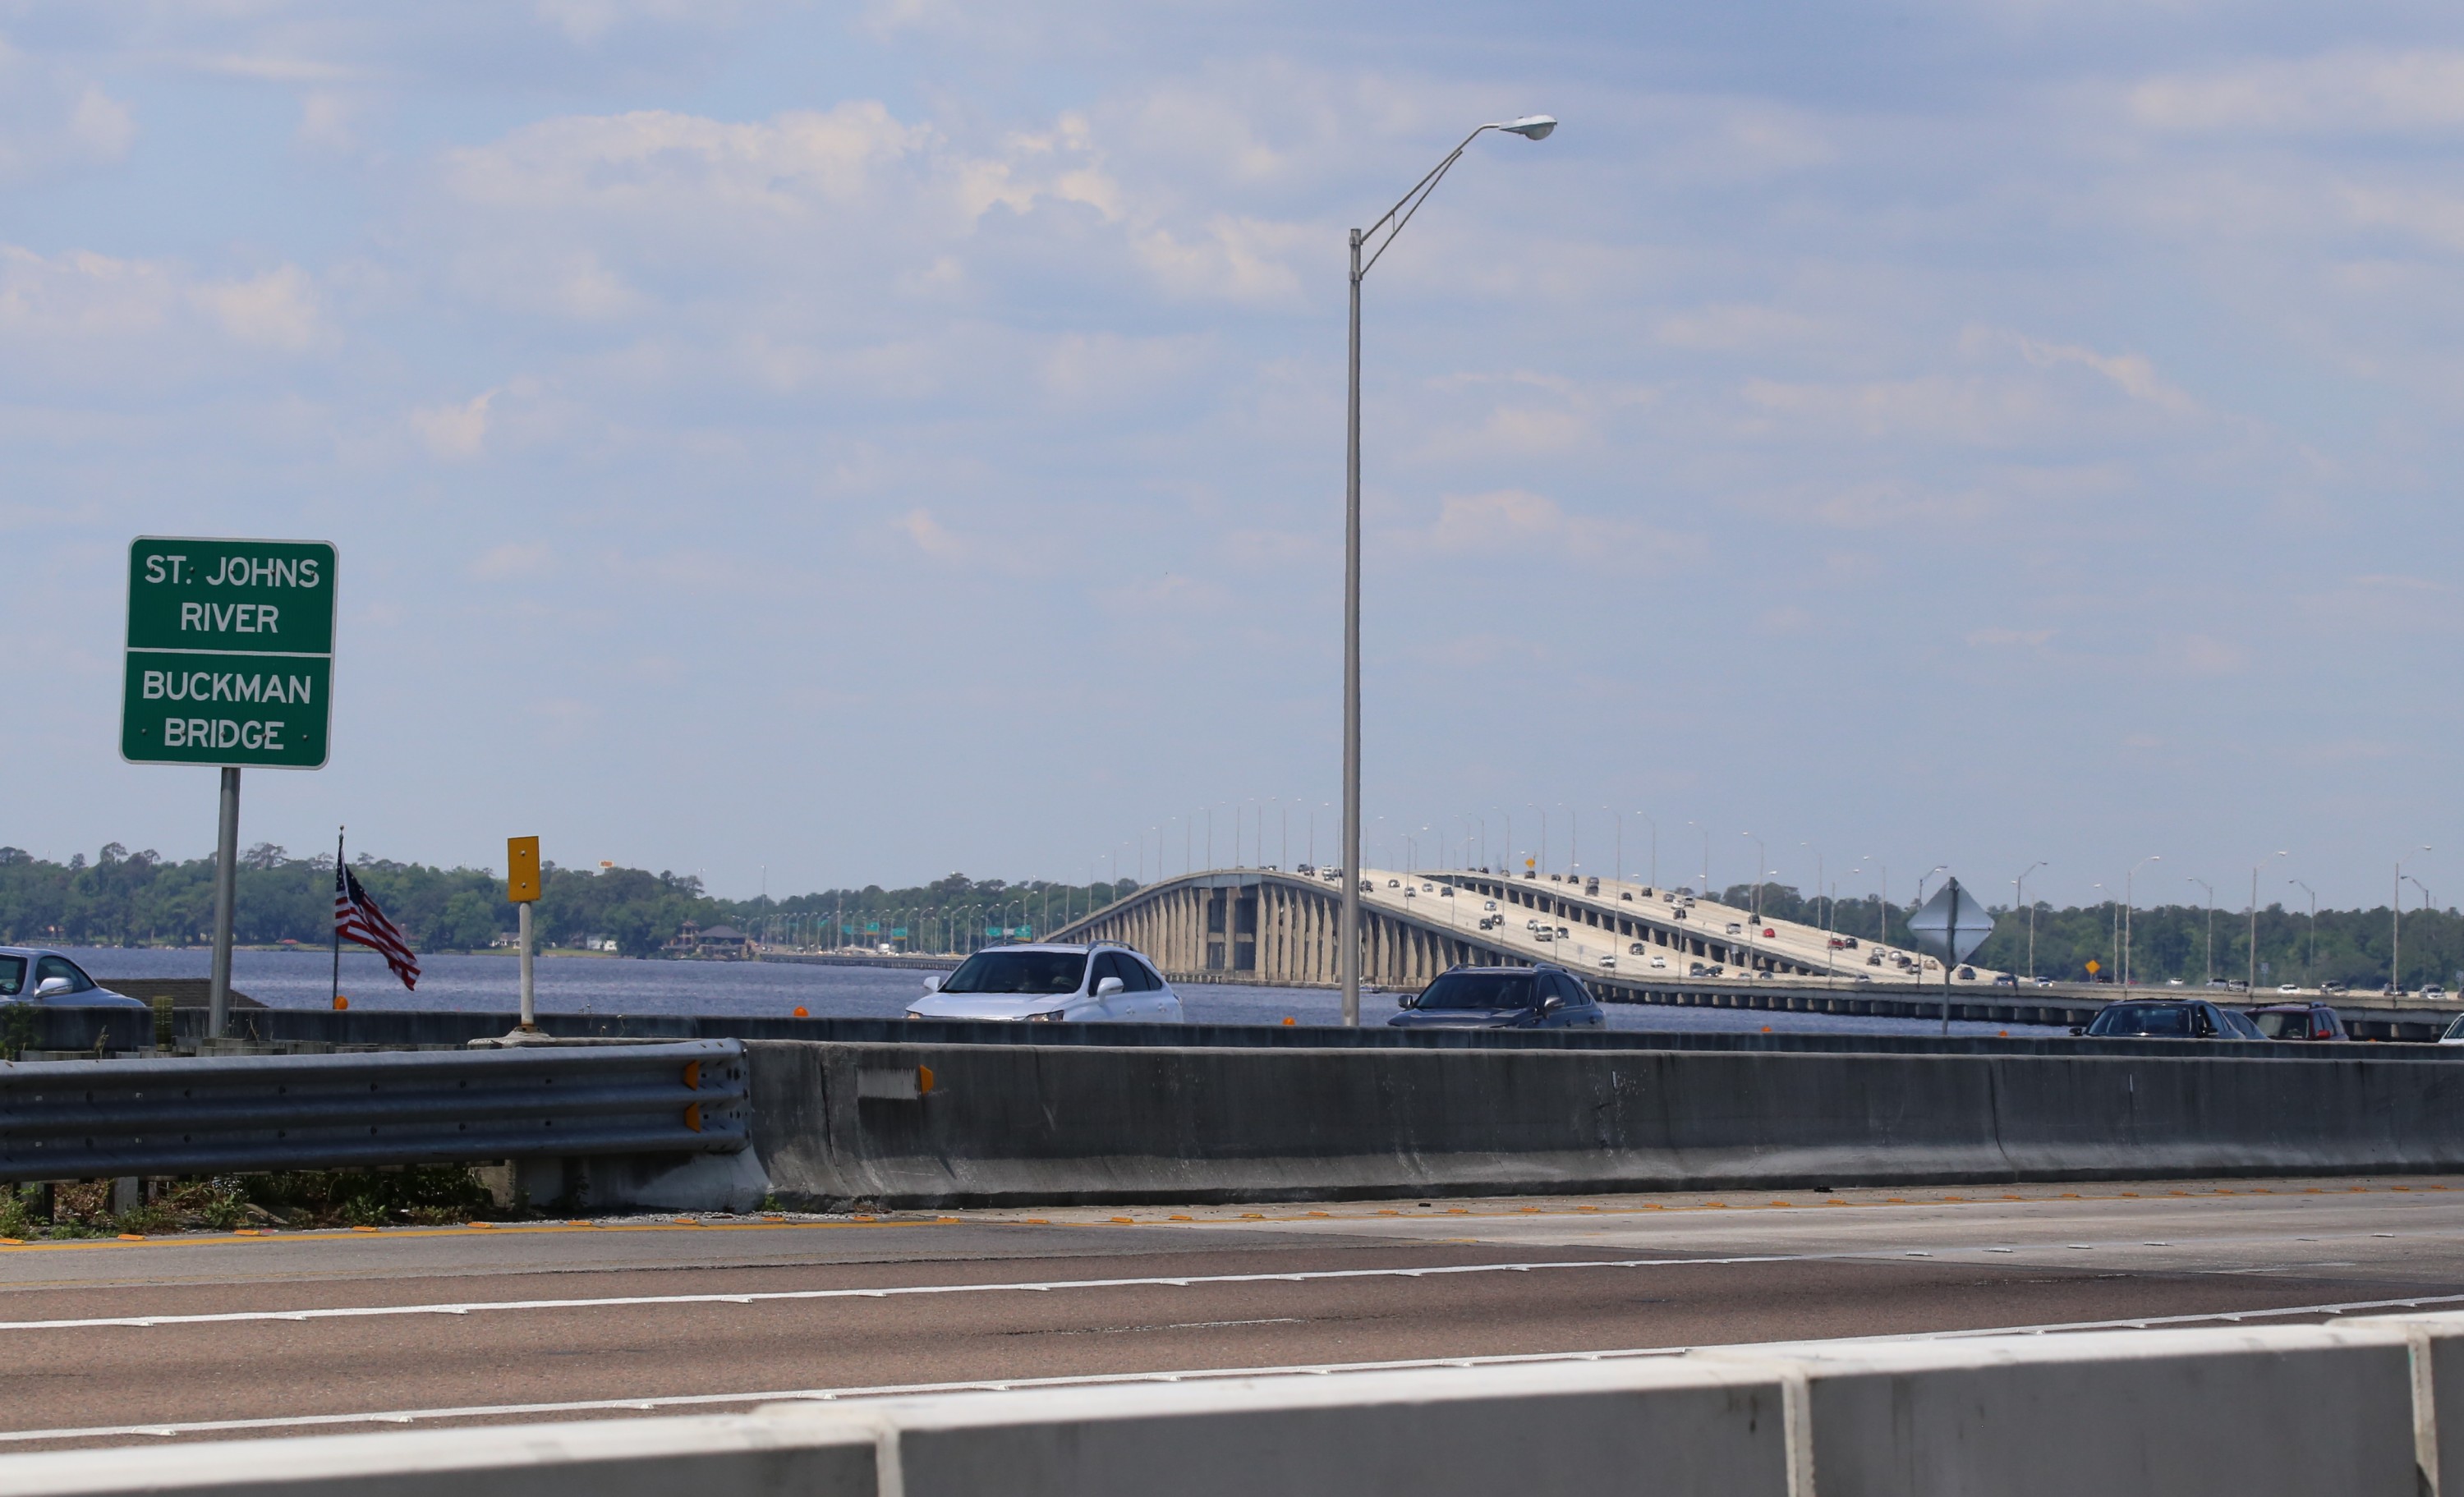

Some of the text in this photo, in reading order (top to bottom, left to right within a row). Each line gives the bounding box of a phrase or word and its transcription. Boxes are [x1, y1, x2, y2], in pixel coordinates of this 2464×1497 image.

[145, 555, 319, 588] ST. JOHNS
[182, 602, 278, 633] RIVER
[143, 670, 311, 704] BUCKMAN
[164, 718, 284, 750] BRIDGE
